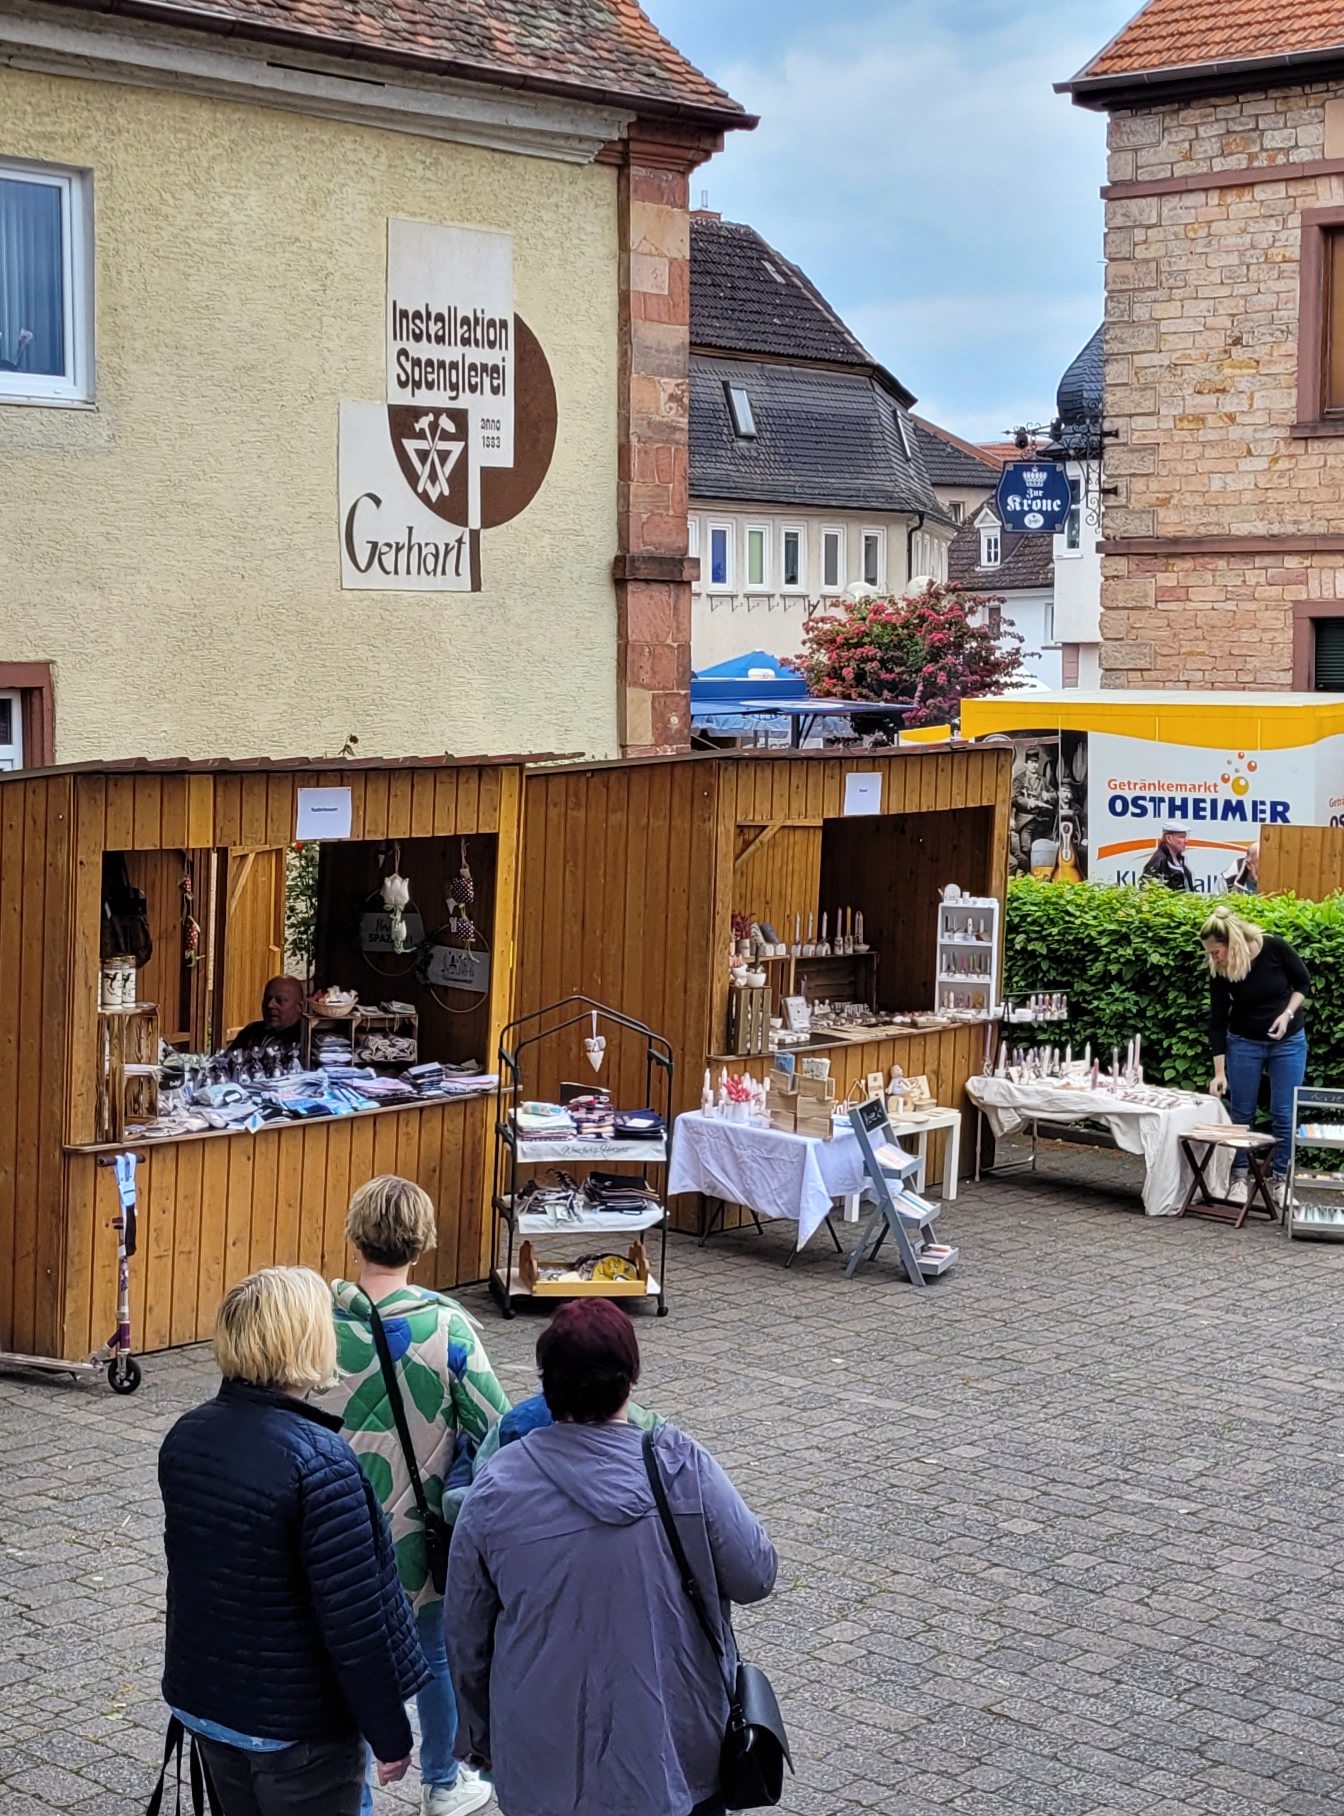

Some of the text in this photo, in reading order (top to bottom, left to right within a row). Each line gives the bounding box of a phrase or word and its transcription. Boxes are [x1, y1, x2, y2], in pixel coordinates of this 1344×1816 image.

[392, 300, 509, 351] Installation
[396, 347, 507, 401] Spenglerei
[481, 417, 501, 431] anno
[1006, 494, 1062, 512] Krone
[1026, 488, 1044, 499] Zur
[344, 492, 467, 577] Gerhart
[1107, 778, 1220, 794] Getränkemarkt
[1107, 794, 1292, 824] OSTHEIMER
